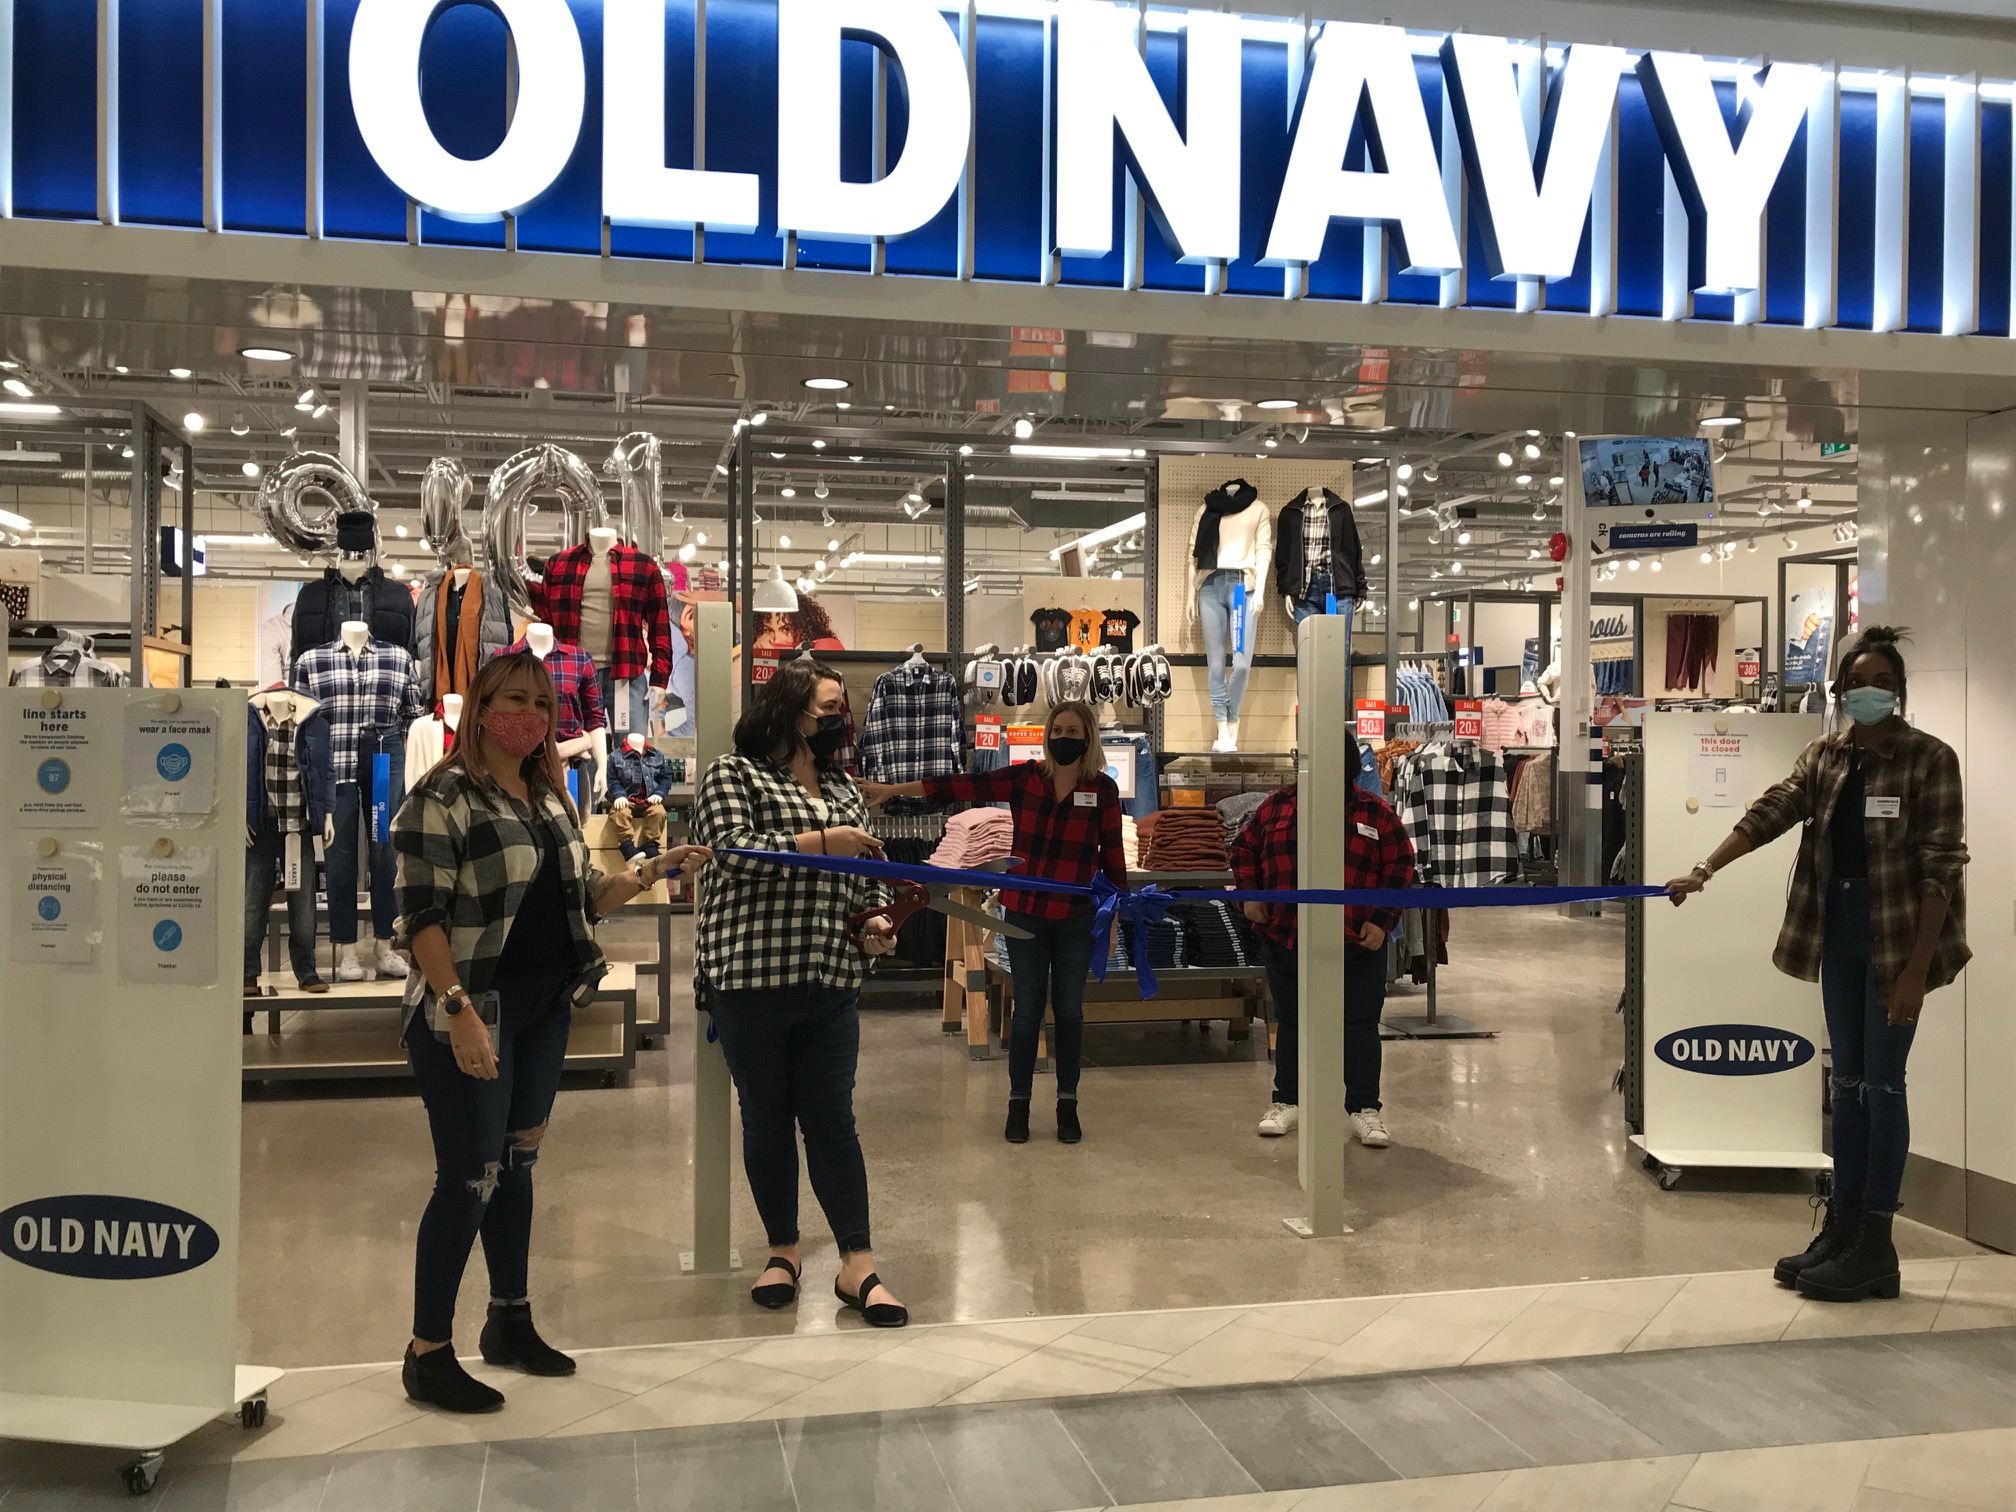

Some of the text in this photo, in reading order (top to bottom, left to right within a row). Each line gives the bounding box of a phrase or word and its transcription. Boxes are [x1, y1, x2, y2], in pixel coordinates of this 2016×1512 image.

[349, 0, 1822, 291] OLD NAVY
[1662, 530, 1686, 538] rolling
[23, 709, 86, 719] line starts
[41, 722, 69, 731] here
[169, 726, 187, 734] face
[189, 726, 211, 734] mask
[379, 801, 385, 811] OG
[32, 873, 67, 881] physical
[151, 872, 186, 883] please
[28, 883, 71, 893] distancing
[136, 884, 200, 894] do not enter
[1672, 1038, 1799, 1062] OLD NAVY
[13, 1216, 196, 1260] OLD NAVY
